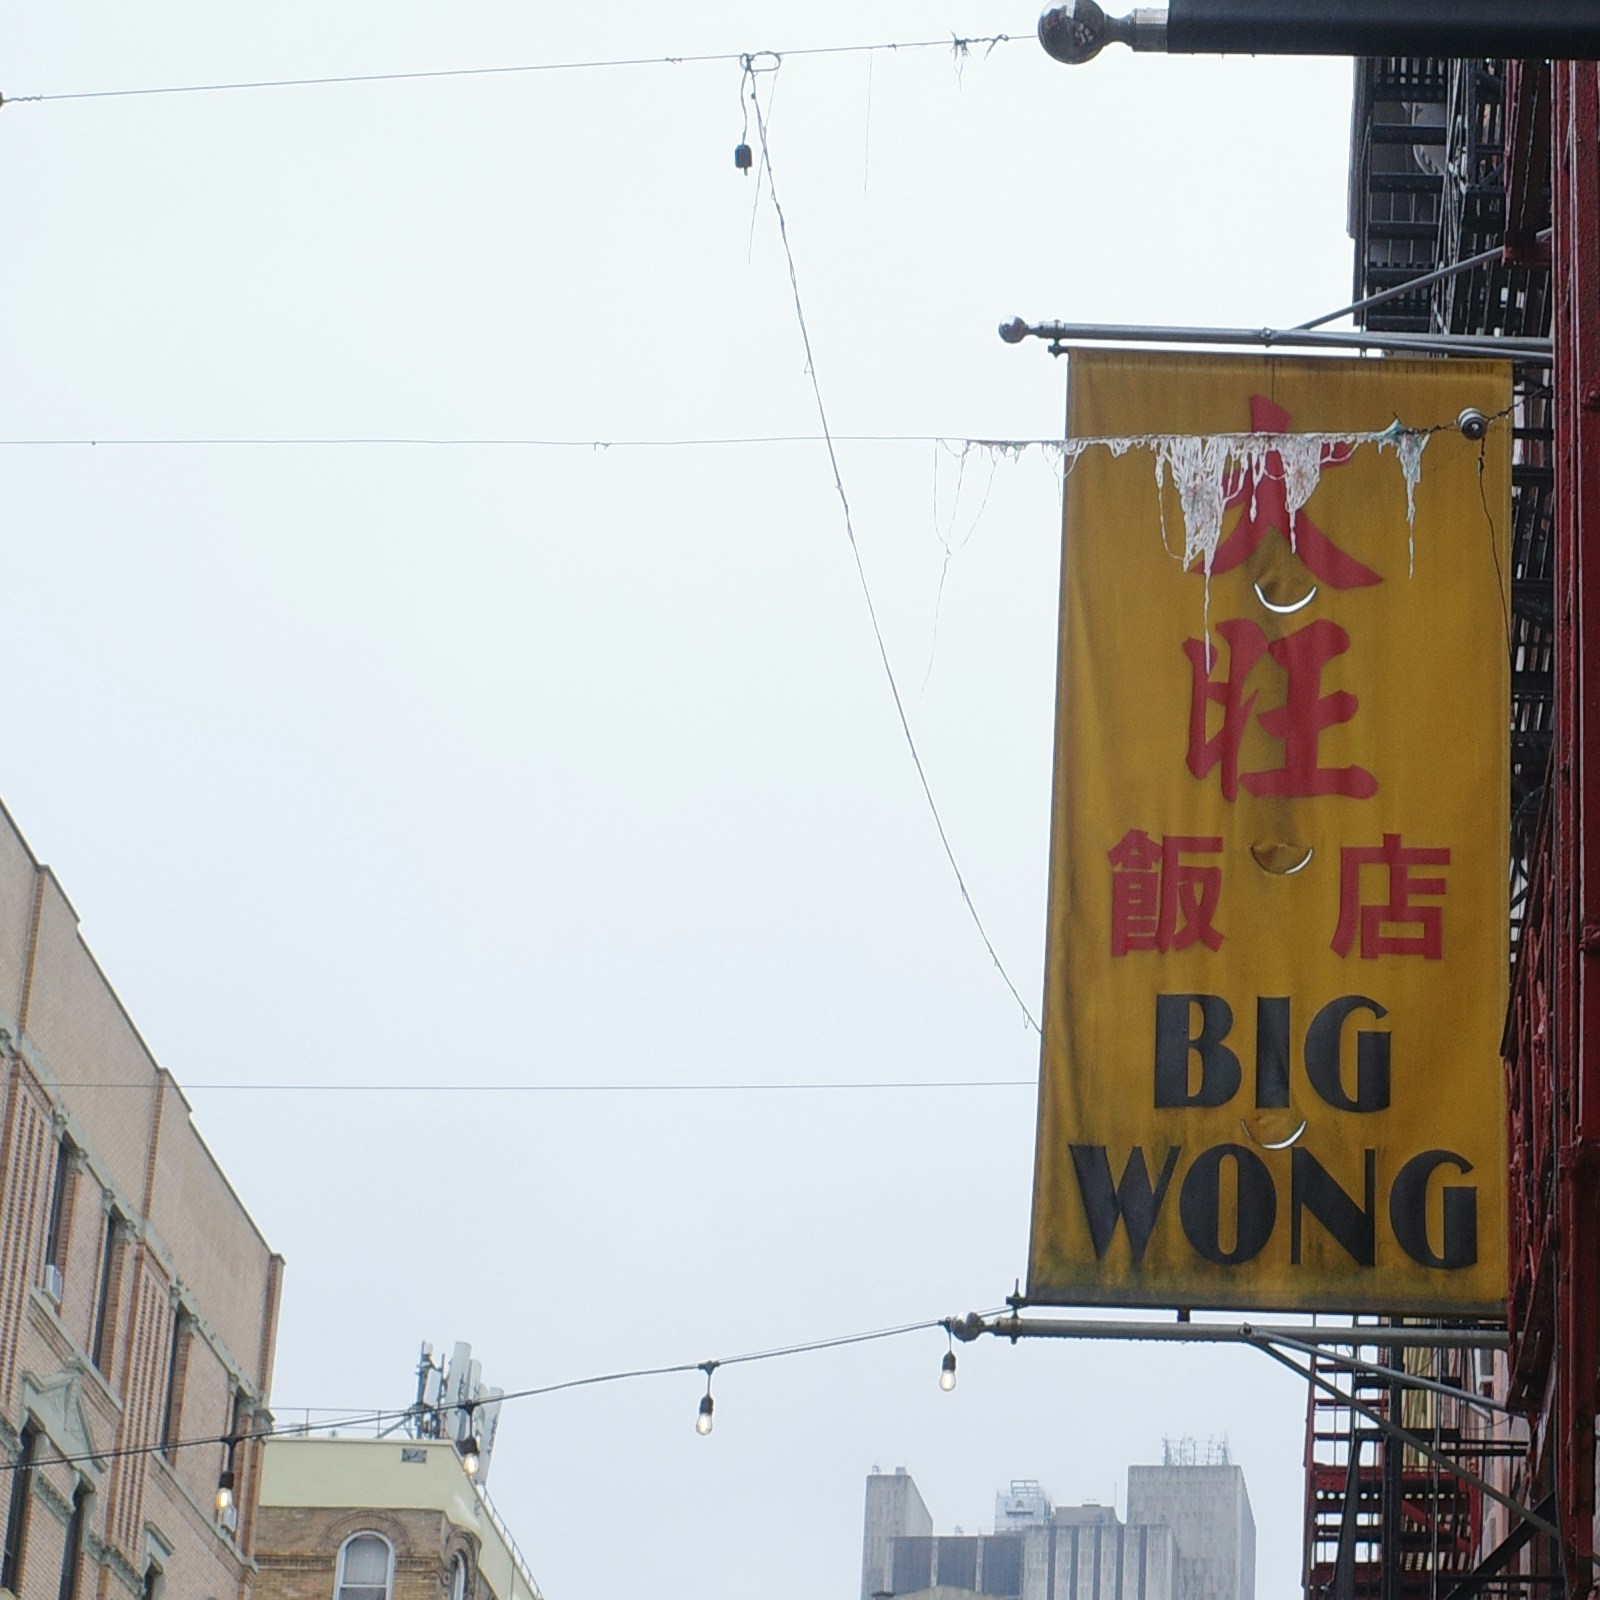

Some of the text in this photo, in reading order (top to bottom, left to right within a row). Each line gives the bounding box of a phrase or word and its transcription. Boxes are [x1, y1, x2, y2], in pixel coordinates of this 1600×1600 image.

[1182, 394, 1383, 800] 大旺
[1108, 829, 1451, 960] 飯店
[1153, 994, 1392, 1113] BIG
[1069, 1145, 1478, 1269] WONG
